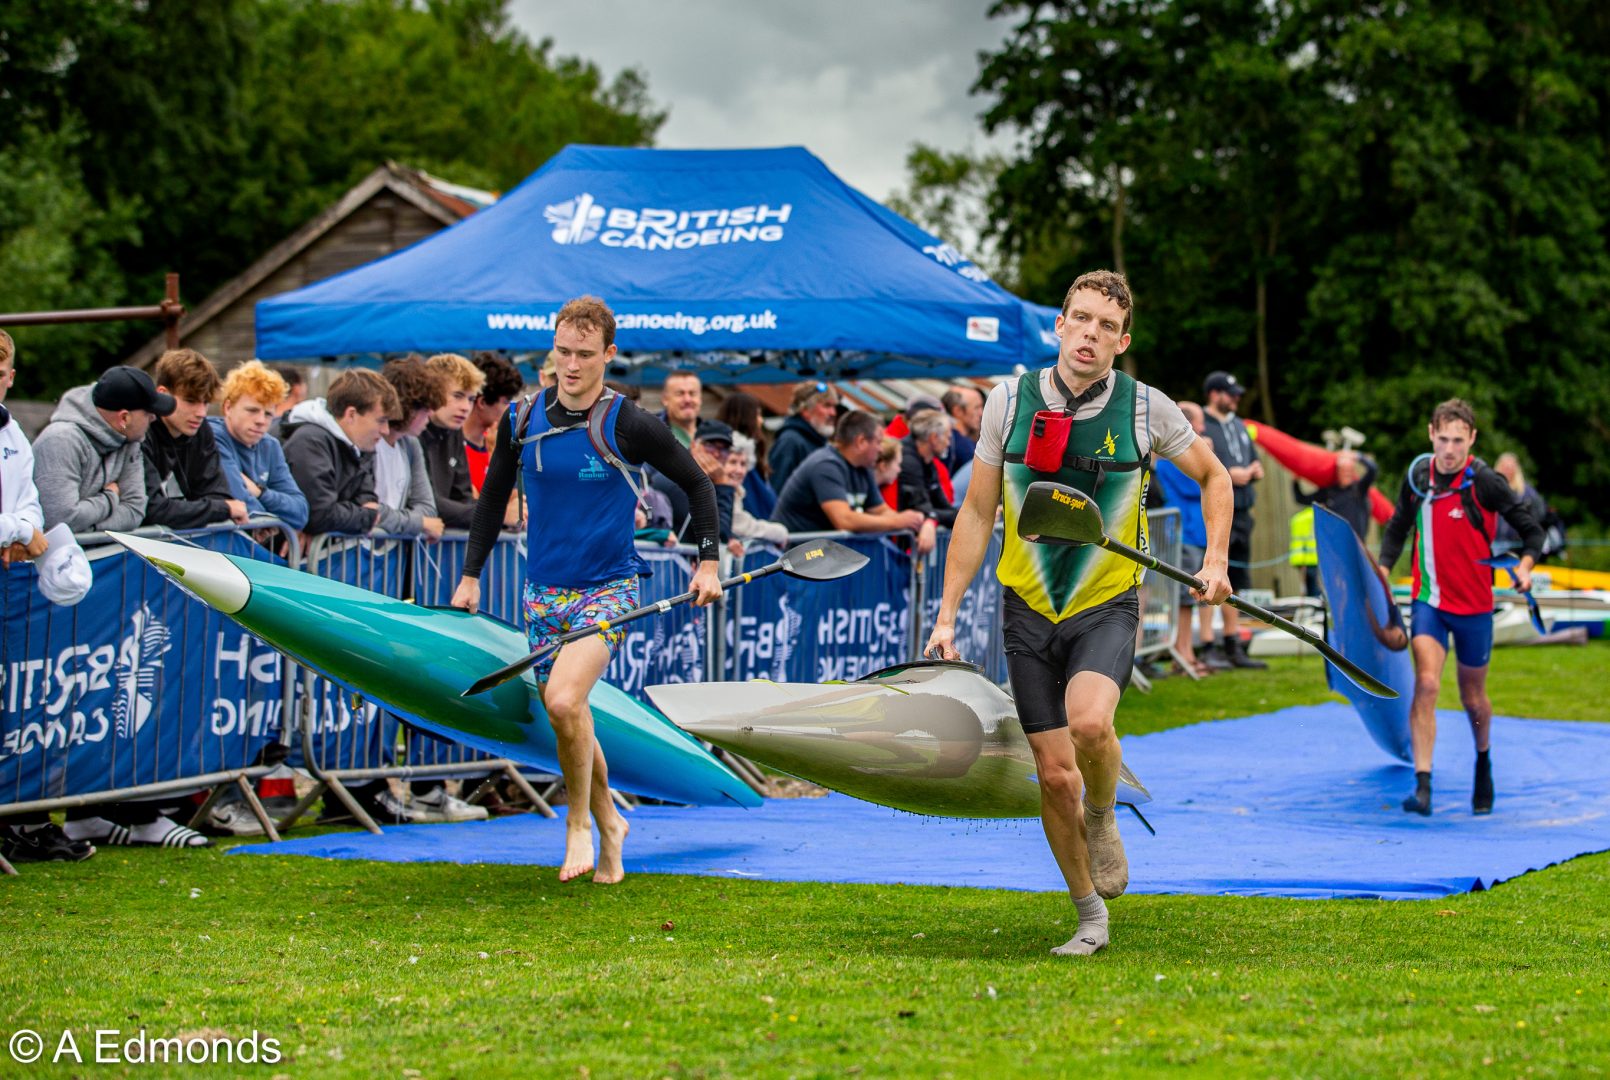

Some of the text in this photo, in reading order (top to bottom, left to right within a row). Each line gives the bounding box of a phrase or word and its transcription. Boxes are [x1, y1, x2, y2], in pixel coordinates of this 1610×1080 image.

[606, 204, 792, 235] BRITISH
[600, 225, 784, 250] CANOEING
[487, 310, 777, 334] www.canoeing.org.uk
